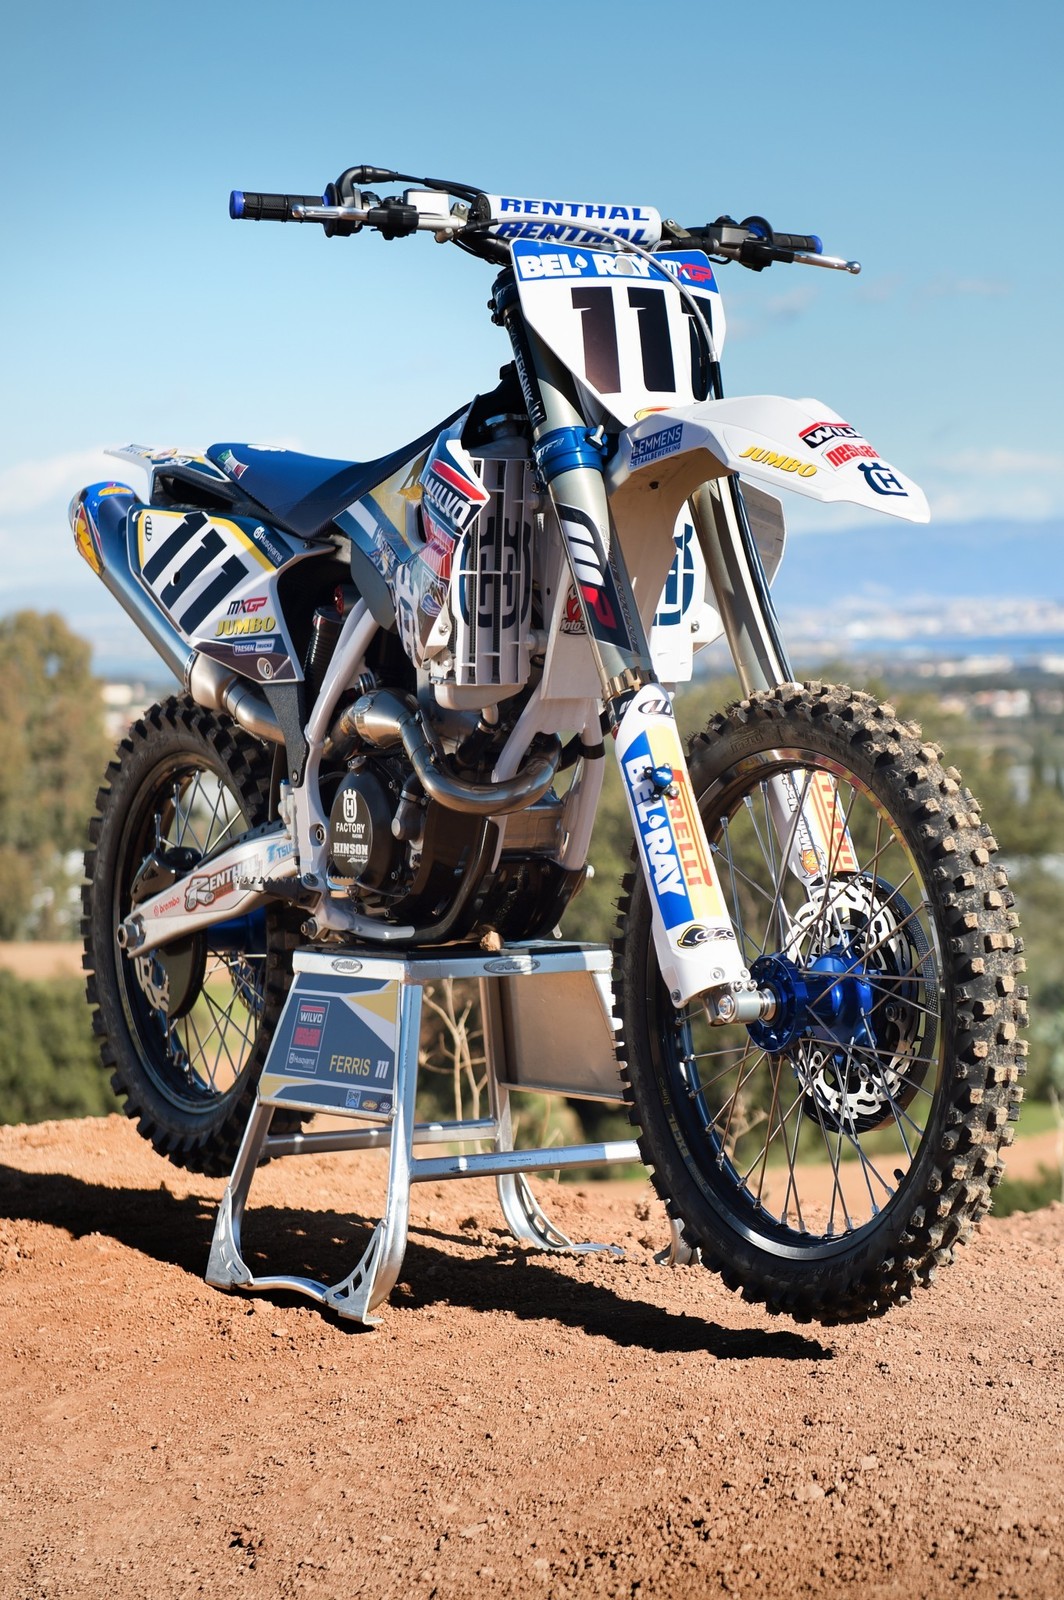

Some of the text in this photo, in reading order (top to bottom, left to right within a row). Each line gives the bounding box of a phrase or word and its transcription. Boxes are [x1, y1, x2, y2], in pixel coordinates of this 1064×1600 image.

[500, 198, 650, 222] RENTHAL
[494, 221, 649, 246] RENTHAL
[517, 254, 582, 279] BEL
[571, 286, 713, 402] 111
[738, 446, 818, 477] JUMBO
[424, 474, 471, 530] WILVO
[142, 511, 250, 636] 111
[226, 596, 268, 616] MXGP
[214, 616, 277, 637] JUMBO
[335, 822, 366, 834] FACTORY
[333, 842, 369, 856] HINSON
[643, 824, 687, 897] RAY
[300, 1011, 324, 1024] WILVO
[329, 1054, 371, 1077] FERRIS
